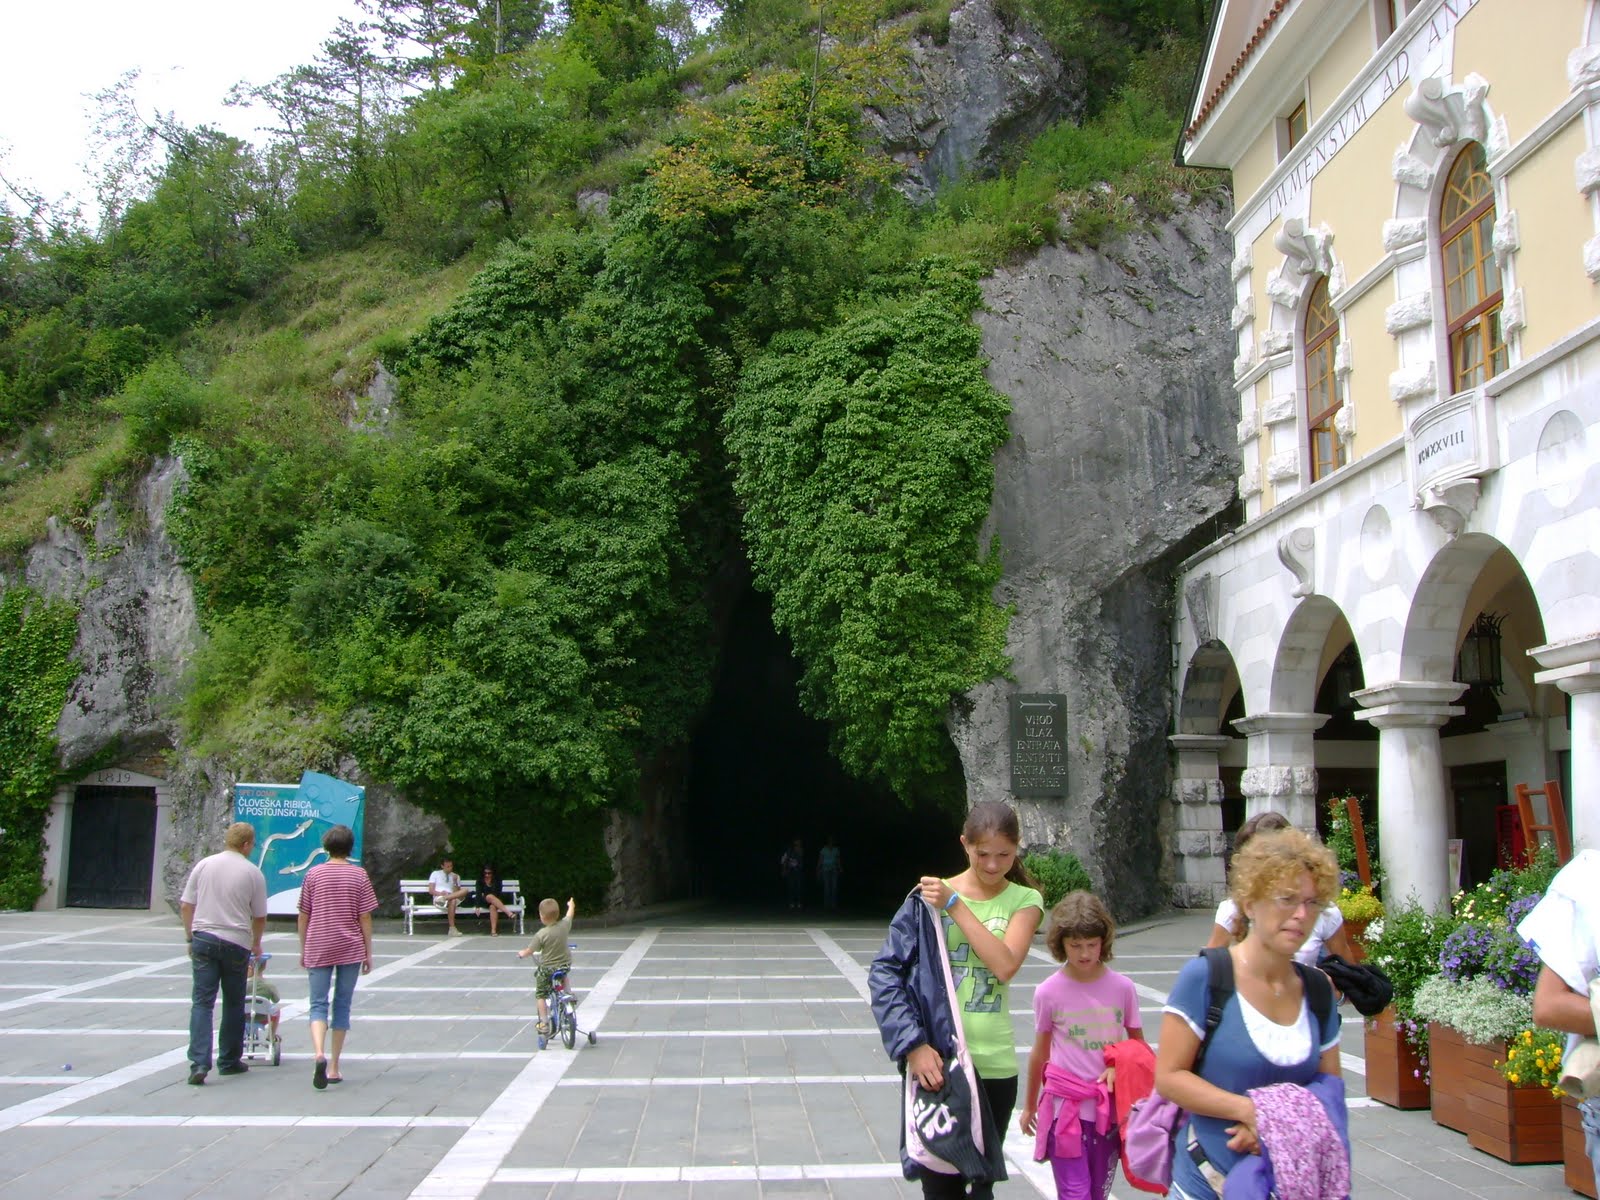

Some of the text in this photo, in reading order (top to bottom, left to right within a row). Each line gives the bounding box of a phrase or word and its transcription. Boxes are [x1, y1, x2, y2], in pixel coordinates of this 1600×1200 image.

[1267, 0, 1474, 222] IMMENSVM AD AN
[1025, 715, 1053, 725] VHOD
[1025, 728, 1053, 738] ULAZ
[1017, 740, 1061, 750] ENTRATA
[1013, 765, 1066, 775] ENTRACE
[97, 772, 131, 783] 1819
[238, 796, 312, 809] ČLOVEŠKA RIBICA
[238, 807, 320, 818] V POSTOJNSKI JAMI
